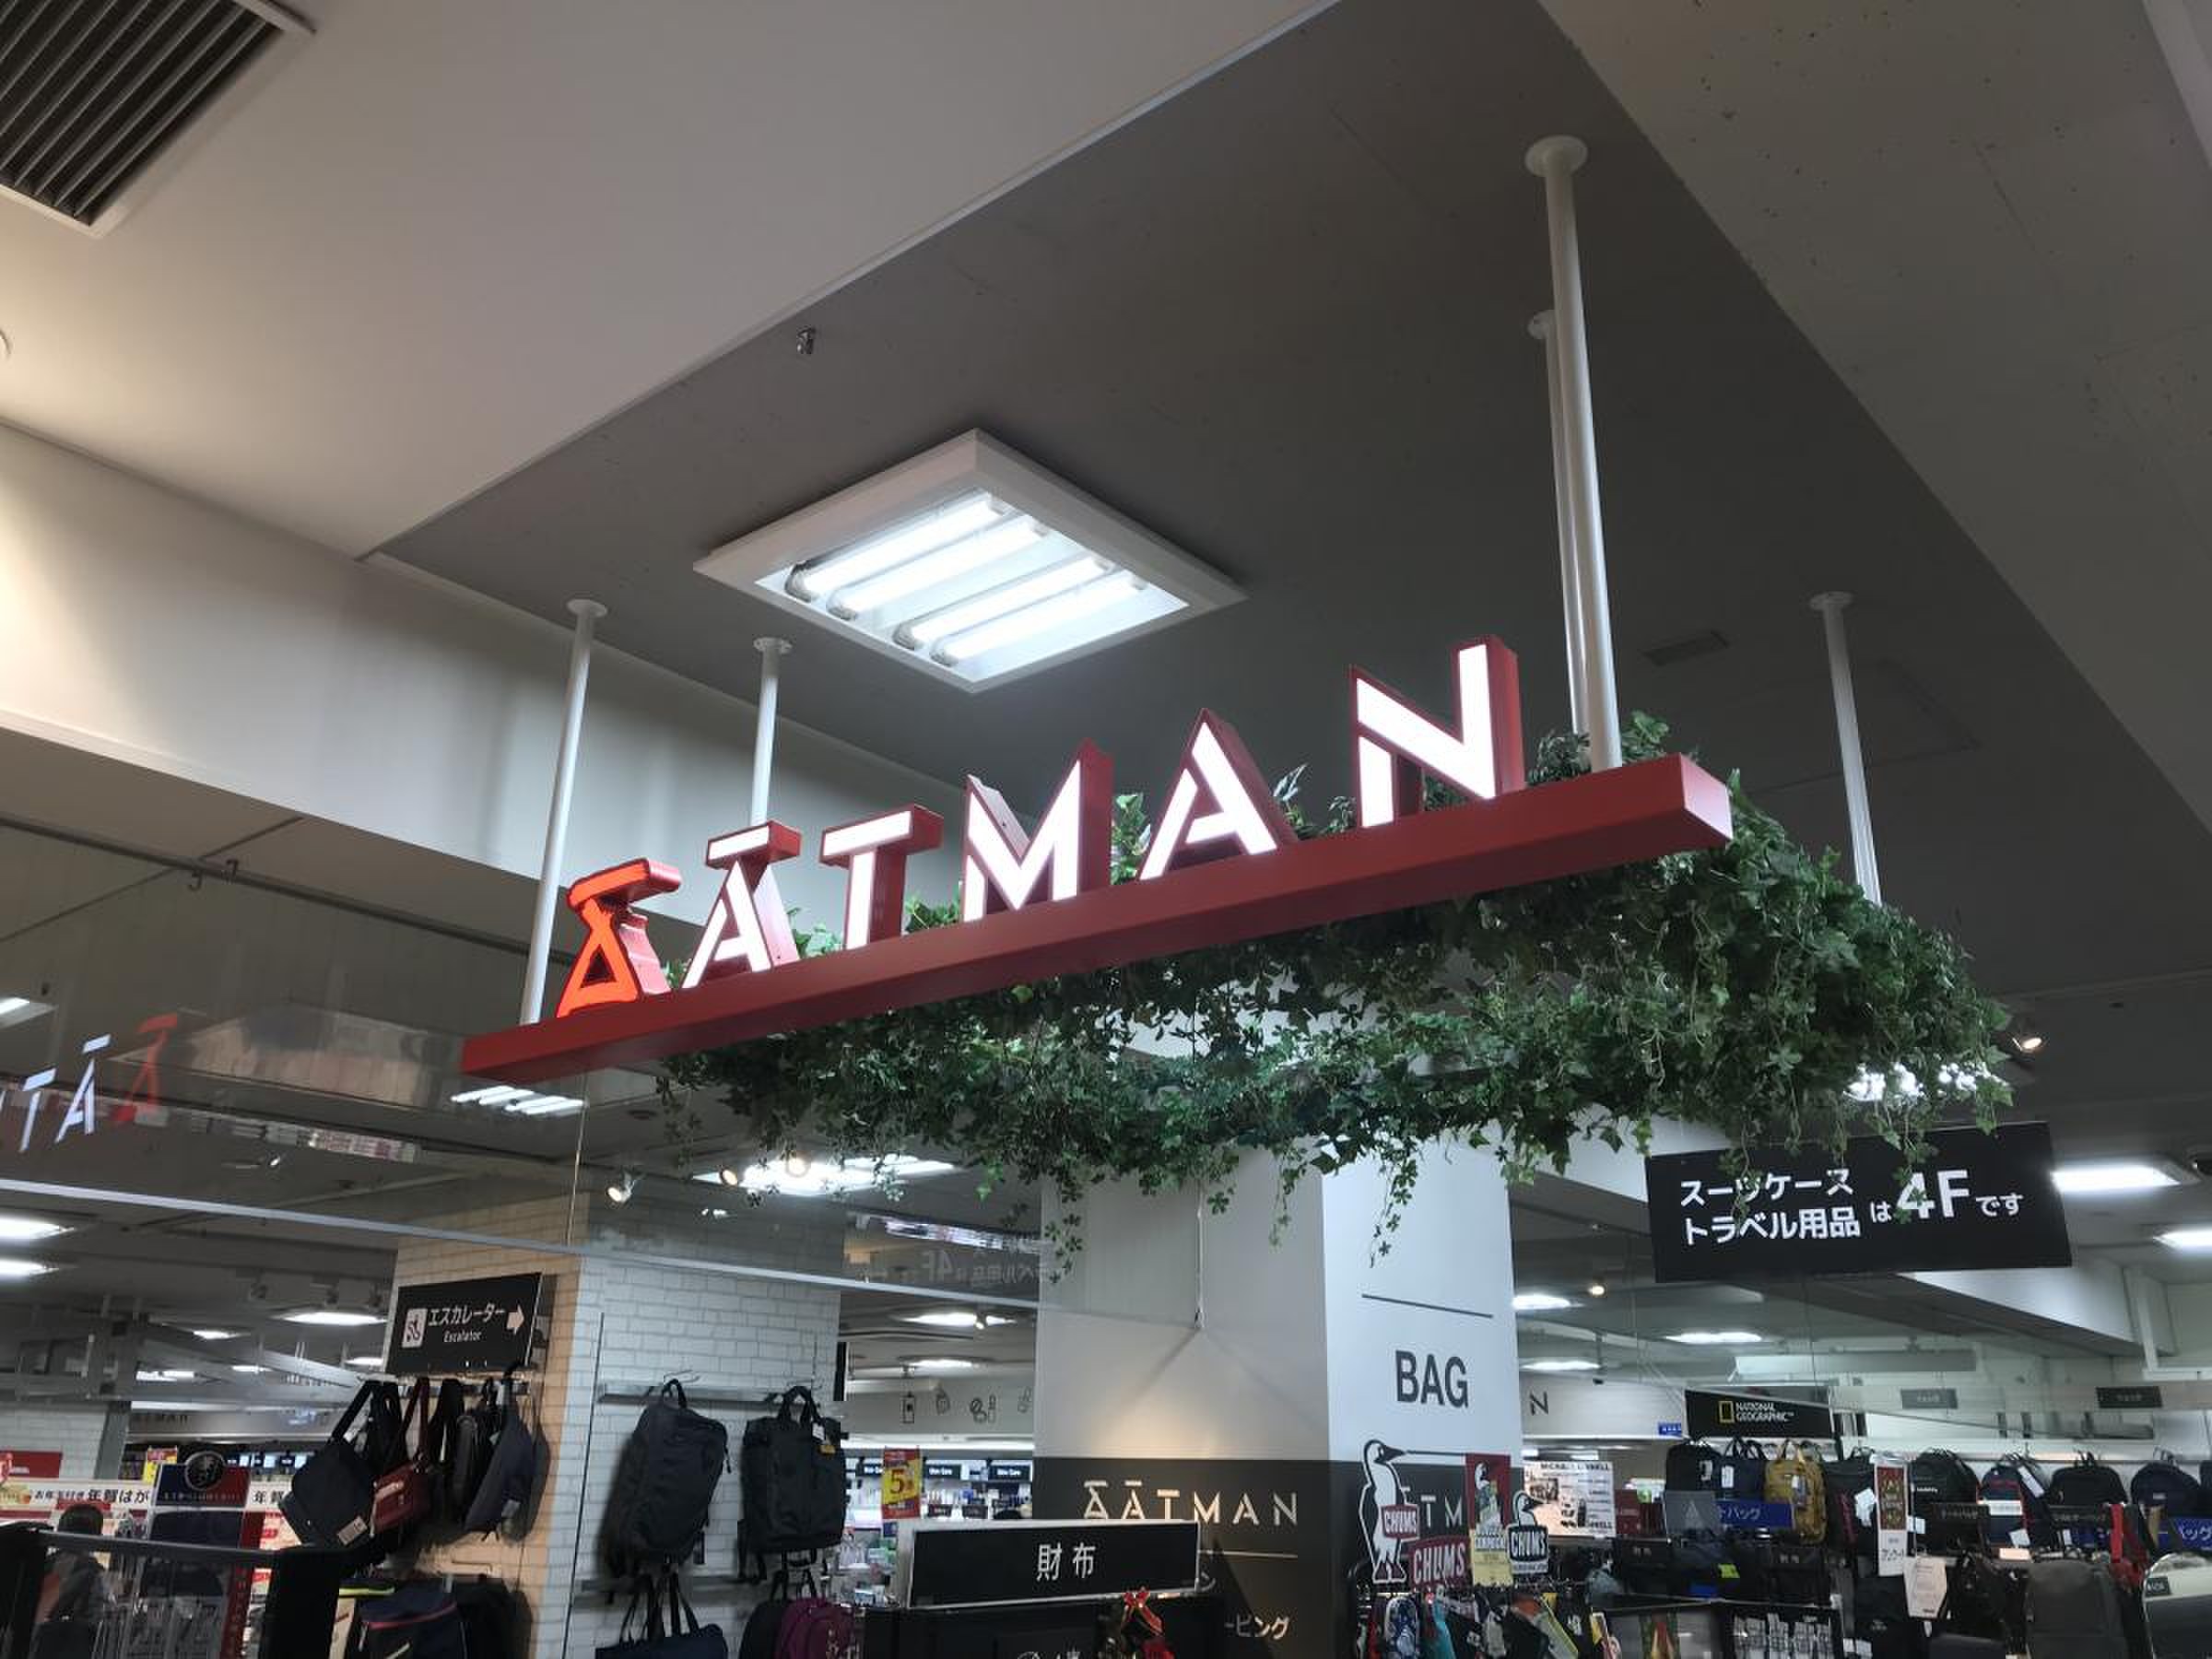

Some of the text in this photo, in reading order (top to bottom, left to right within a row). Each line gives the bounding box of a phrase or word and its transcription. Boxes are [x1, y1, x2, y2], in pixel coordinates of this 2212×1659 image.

[1680, 1168, 1853, 1207] スーツケース
[1683, 1206, 1861, 1246] トラベル用品
[1896, 1169, 1971, 1219] 4F
[1976, 1193, 2024, 1218] です
[428, 1303, 505, 1326] エスカレーター
[443, 1330, 482, 1343] Escalator
[1395, 1349, 1469, 1408] BAG
[1735, 1402, 1775, 1412] NATIONAL
[1384, 1509, 1418, 1534] CHUMS
[1036, 1542, 1096, 1582] 財布
[1511, 1529, 1547, 1560] CHUMS
[1413, 1541, 1466, 1584] CHUMS
